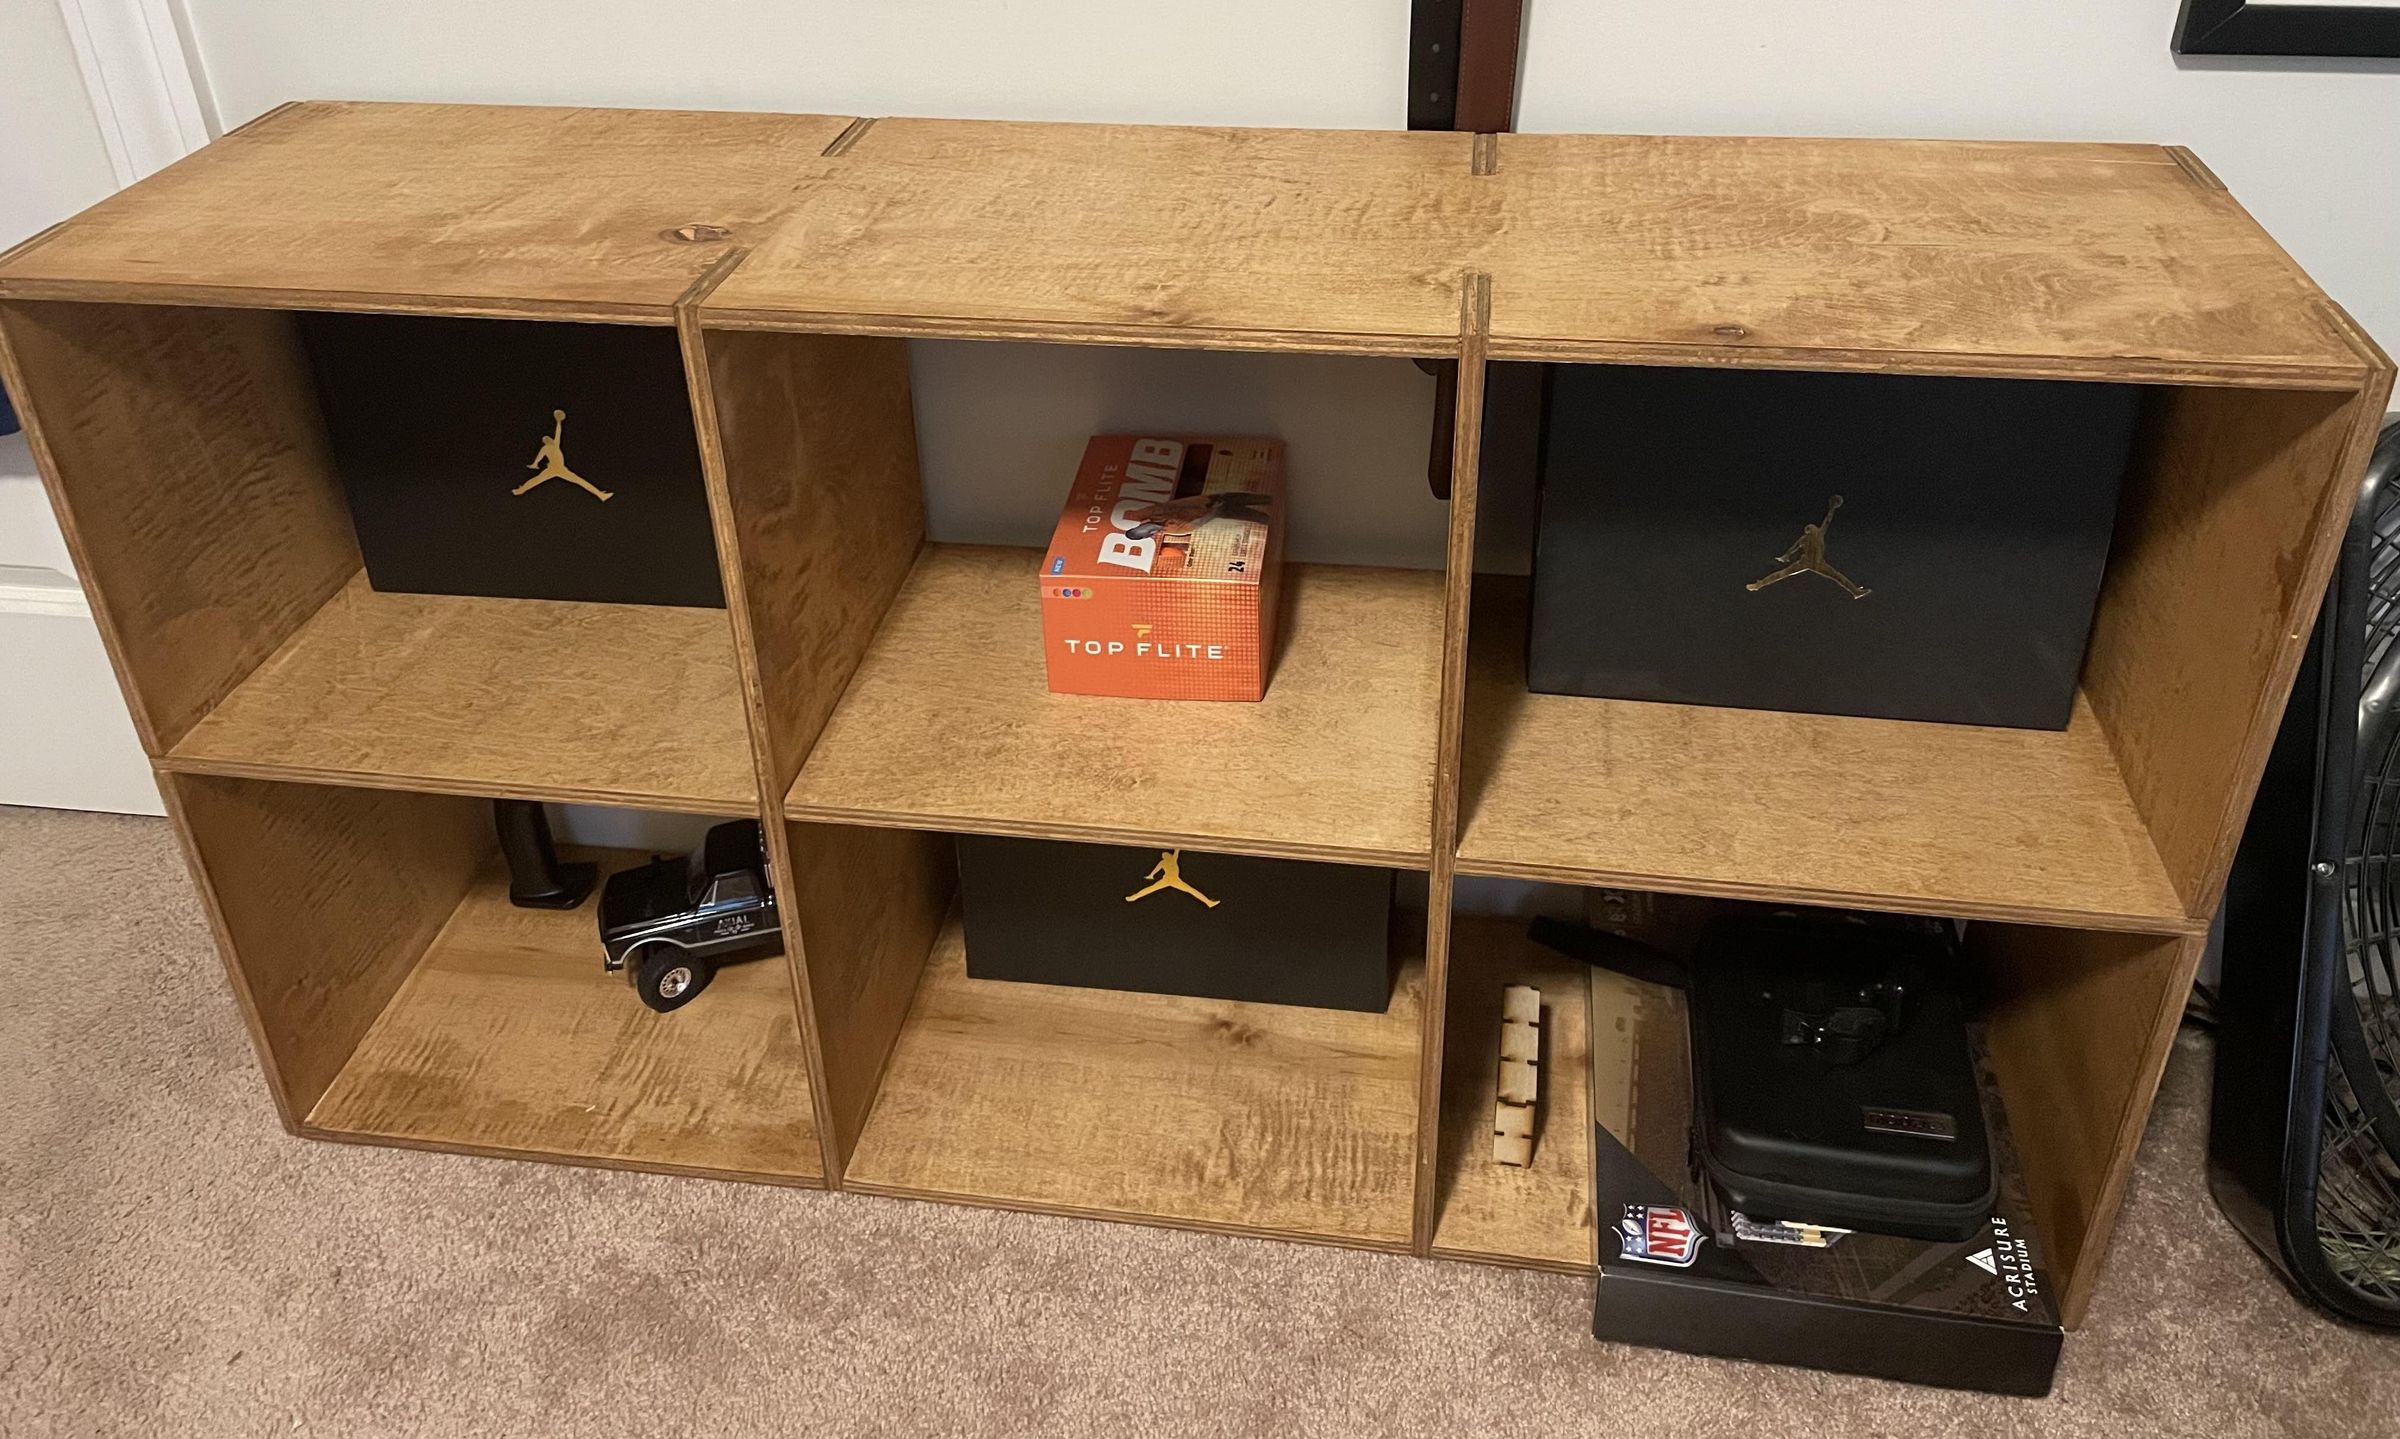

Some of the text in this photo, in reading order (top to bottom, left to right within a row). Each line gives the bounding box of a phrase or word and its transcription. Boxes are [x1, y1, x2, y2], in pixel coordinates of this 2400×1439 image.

[1083, 464, 1118, 533] TOP FLITE
[1097, 438, 1184, 574] BOMB
[1052, 558, 1064, 573] NEW
[1228, 560, 1246, 573] 24
[1064, 639, 1224, 659] TOP FLITE
[1648, 1208, 1690, 1257] NFL
[1991, 1217, 2028, 1312] ACRISURE
[2014, 1239, 2038, 1294] STADIUM
